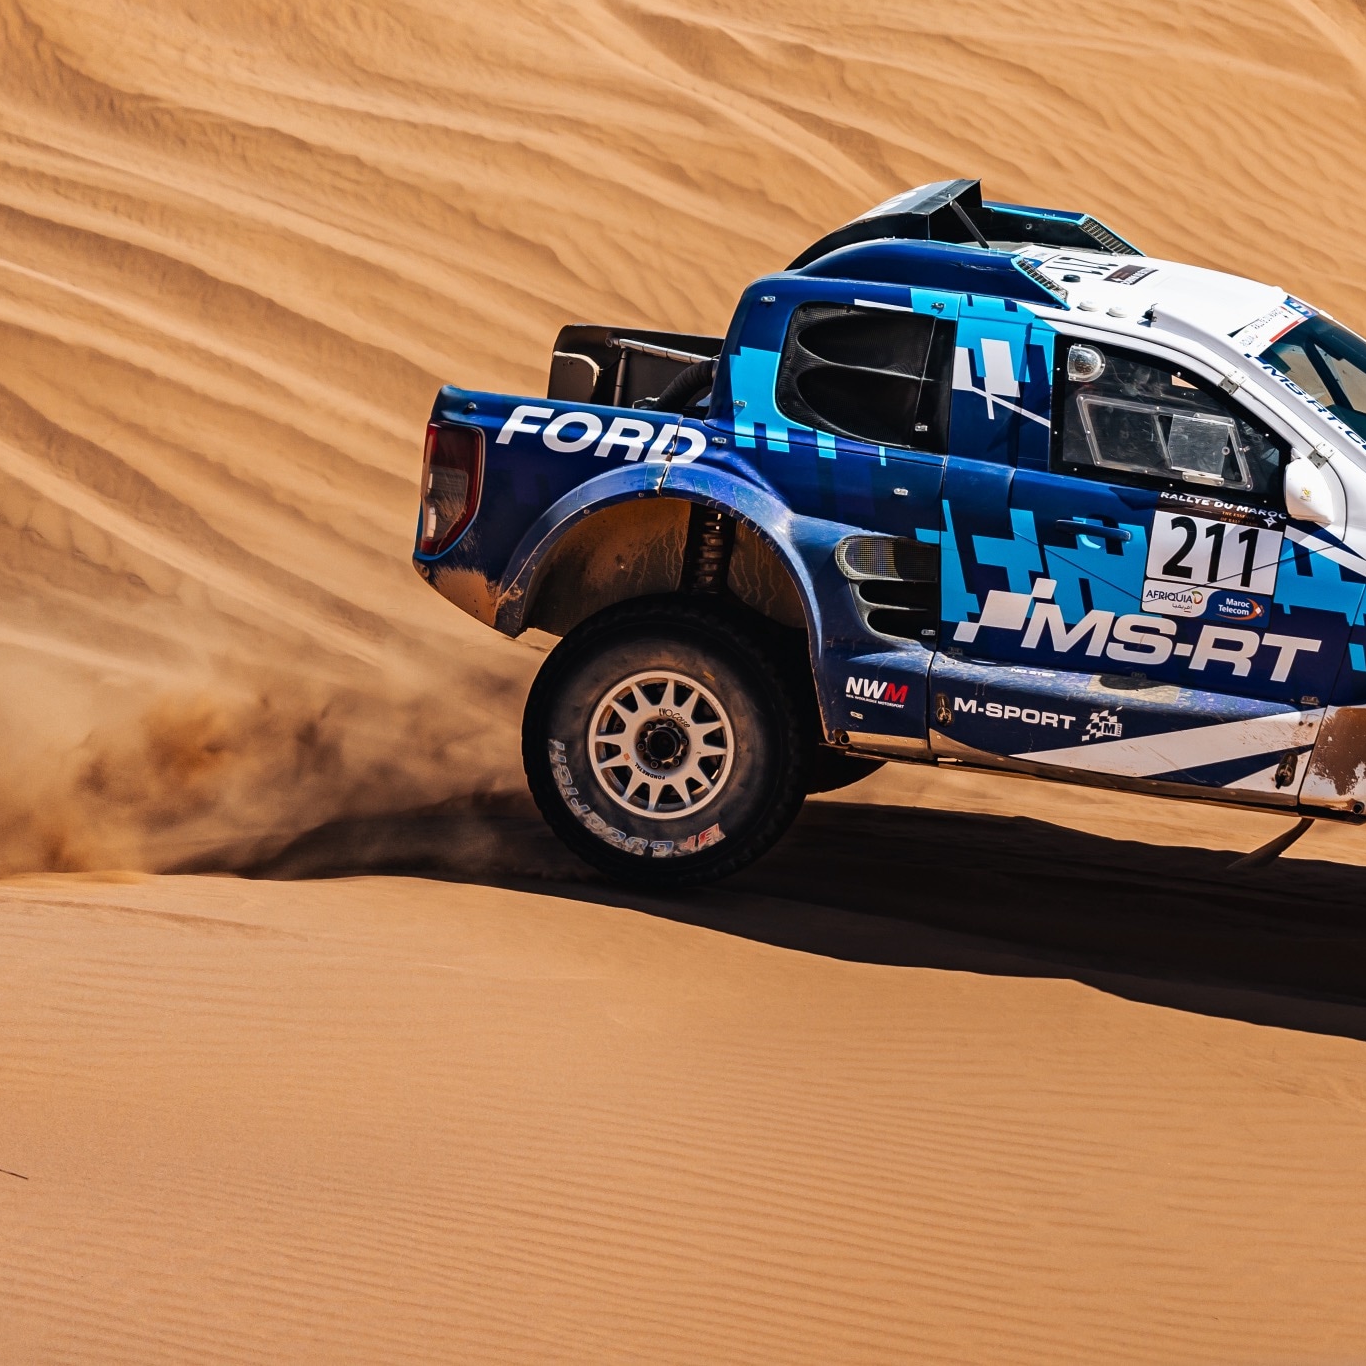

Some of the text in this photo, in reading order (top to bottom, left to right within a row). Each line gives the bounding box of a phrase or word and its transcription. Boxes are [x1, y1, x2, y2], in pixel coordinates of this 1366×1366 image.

[495, 405, 707, 465] FORD
[1160, 491, 1287, 520] RALLYE DU MAROC
[1161, 516, 1259, 588] 211
[1146, 589, 1193, 604] AFRIQUIA
[1218, 604, 1250, 616] Telecom
[1226, 597, 1250, 608] Maroc
[1021, 602, 1322, 684] MS-RT
[845, 676, 909, 704] NWM
[954, 696, 1076, 730] M-SPORT
[635, 761, 666, 781] FONDMETAL
